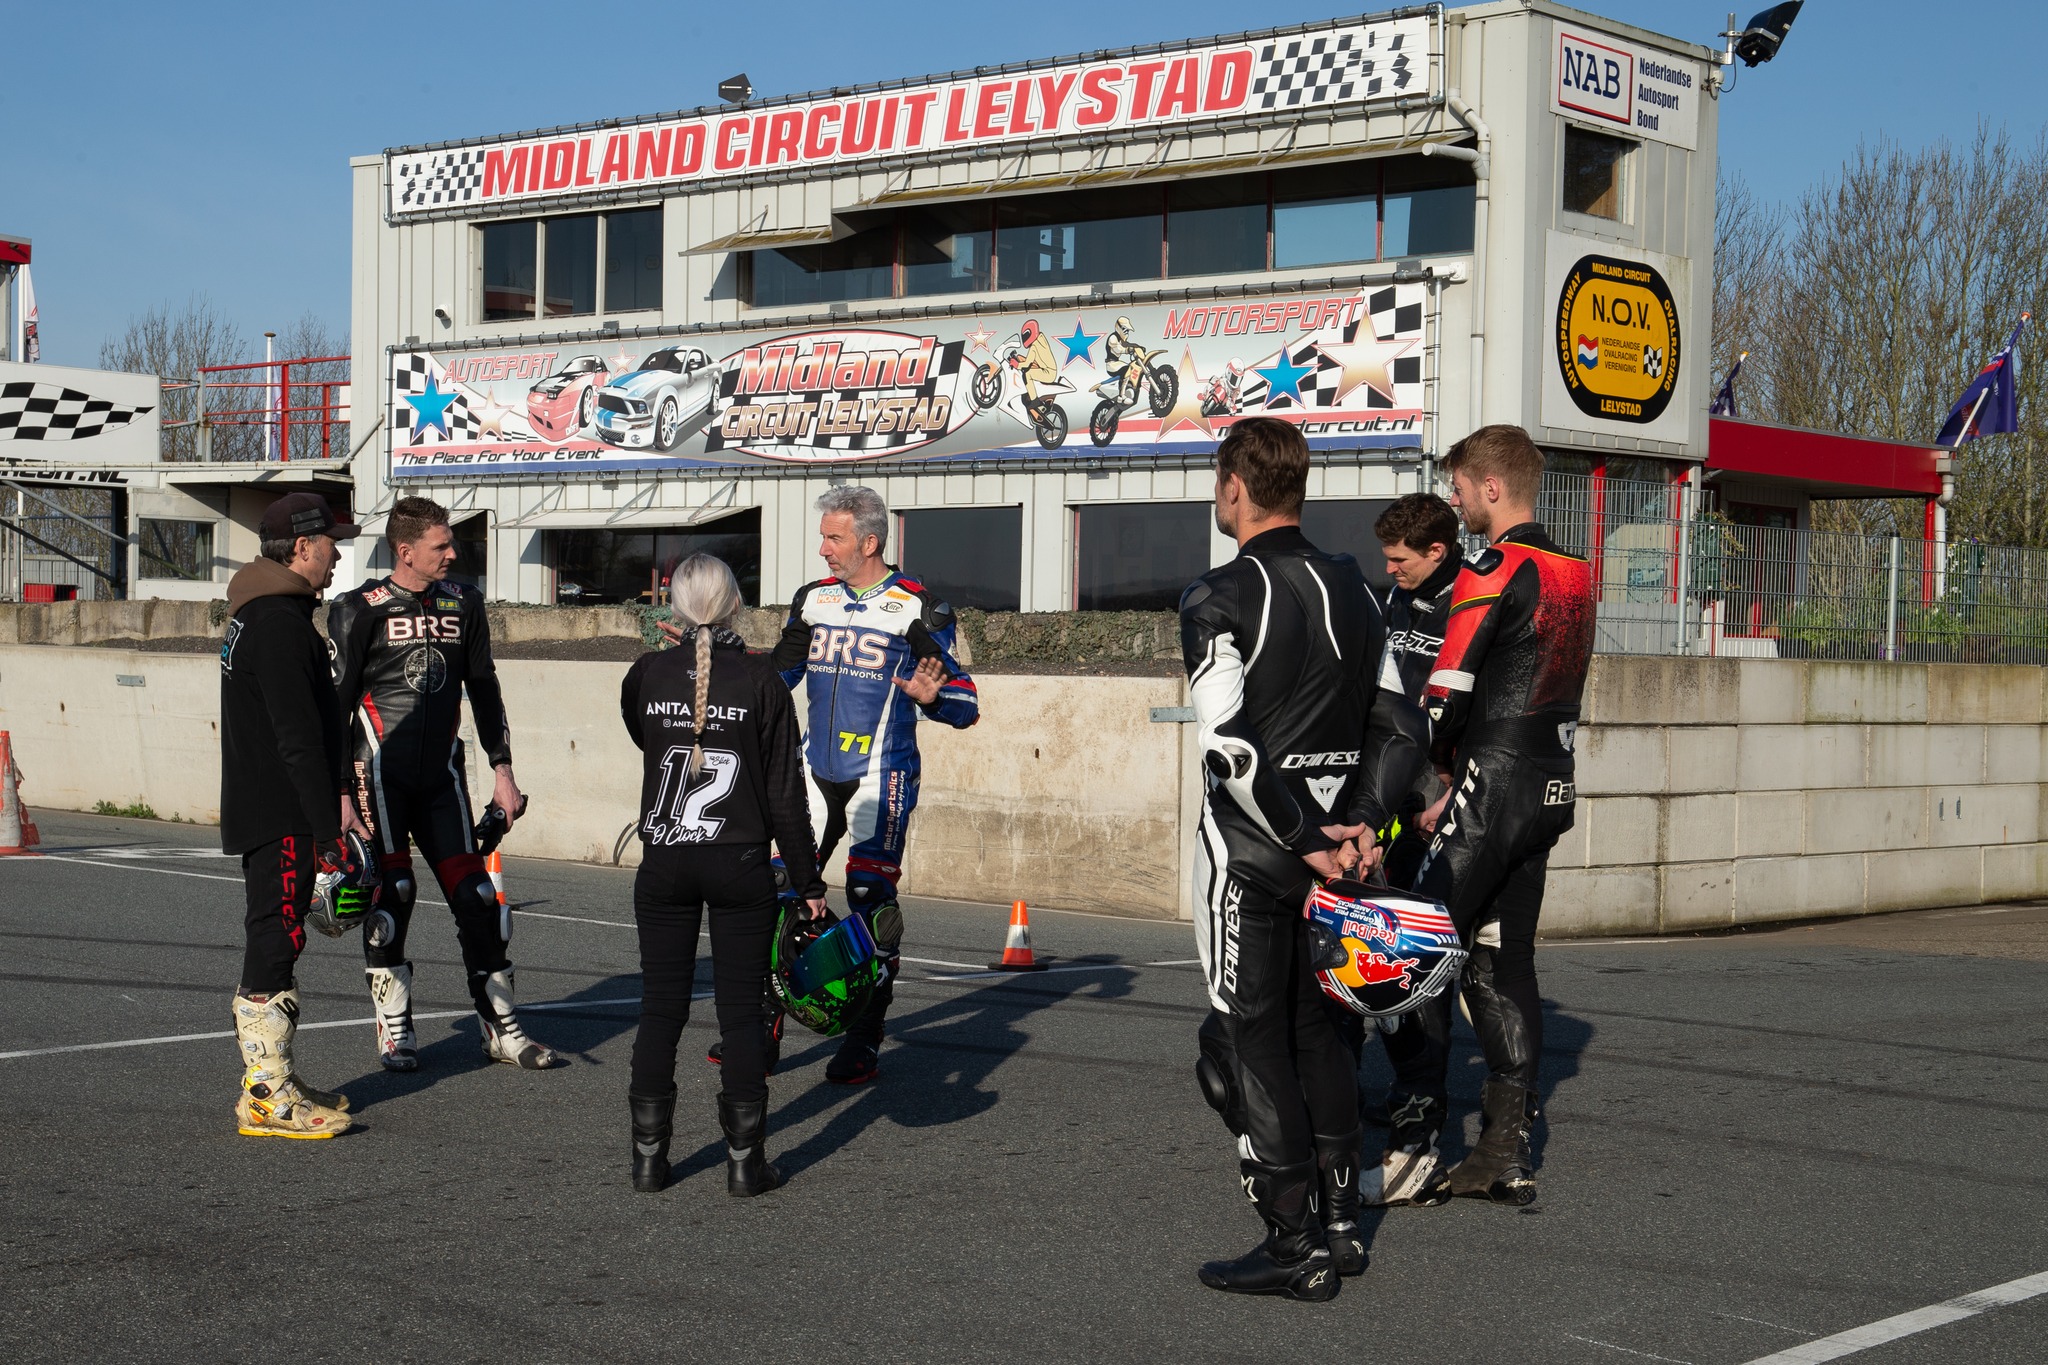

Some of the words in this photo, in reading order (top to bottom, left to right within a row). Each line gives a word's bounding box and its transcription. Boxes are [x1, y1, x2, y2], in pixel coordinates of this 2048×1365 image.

[1563, 46, 1620, 99] NAB
[1639, 57, 1692, 88] Nederlandse
[1638, 83, 1679, 111] Autosport
[481, 123, 707, 198] MIDLAND
[713, 91, 938, 171] CIRCUIT
[942, 50, 1254, 143] LELYSTAD
[1637, 109, 1659, 131] Bond
[1592, 262, 1622, 278] MIDLAND
[1624, 269, 1651, 283] CIRCUIT
[1163, 297, 1364, 339] MOTORSPORT
[1593, 293, 1650, 331] N.O.V.
[1561, 271, 1581, 389] AUTOSPEEDWAY
[1602, 337, 1640, 351] NEDERLANDSE
[1664, 299, 1677, 392] OVALRACING
[738, 335, 938, 395] Midland
[1604, 349, 1637, 362] OVALRACING
[1604, 360, 1637, 373] VERENIGING
[441, 351, 559, 384] AUTOSPORT
[720, 400, 816, 440] CIRCUIT
[816, 395, 951, 436] LELYSTAD
[1601, 399, 1641, 417] LELYSTAD
[1217, 415, 1417, 437] mdcircuit.nl
[401, 453, 427, 465] The
[431, 452, 473, 464] Place
[477, 450, 506, 462] For
[512, 449, 551, 461] Your
[554, 447, 605, 460] Event
[817, 595, 841, 604] MOLY
[388, 615, 461, 639] BRS
[807, 627, 889, 669] BRS
[850, 669, 884, 681] works
[646, 702, 691, 716] ANITA
[707, 706, 748, 721] OLET
[839, 731, 872, 755] 71
[1281, 749, 1361, 769] DAINESE
[643, 745, 741, 840] 12
[665, 825, 706, 845] Clock
[1334, 907, 1350, 917] PRIX
[1336, 900, 1371, 912] AMERICAS
[1342, 919, 1368, 938] Bull
[1350, 911, 1374, 924] GRAND
[1224, 880, 1243, 995] DAINESE
[1368, 926, 1397, 946] Red
